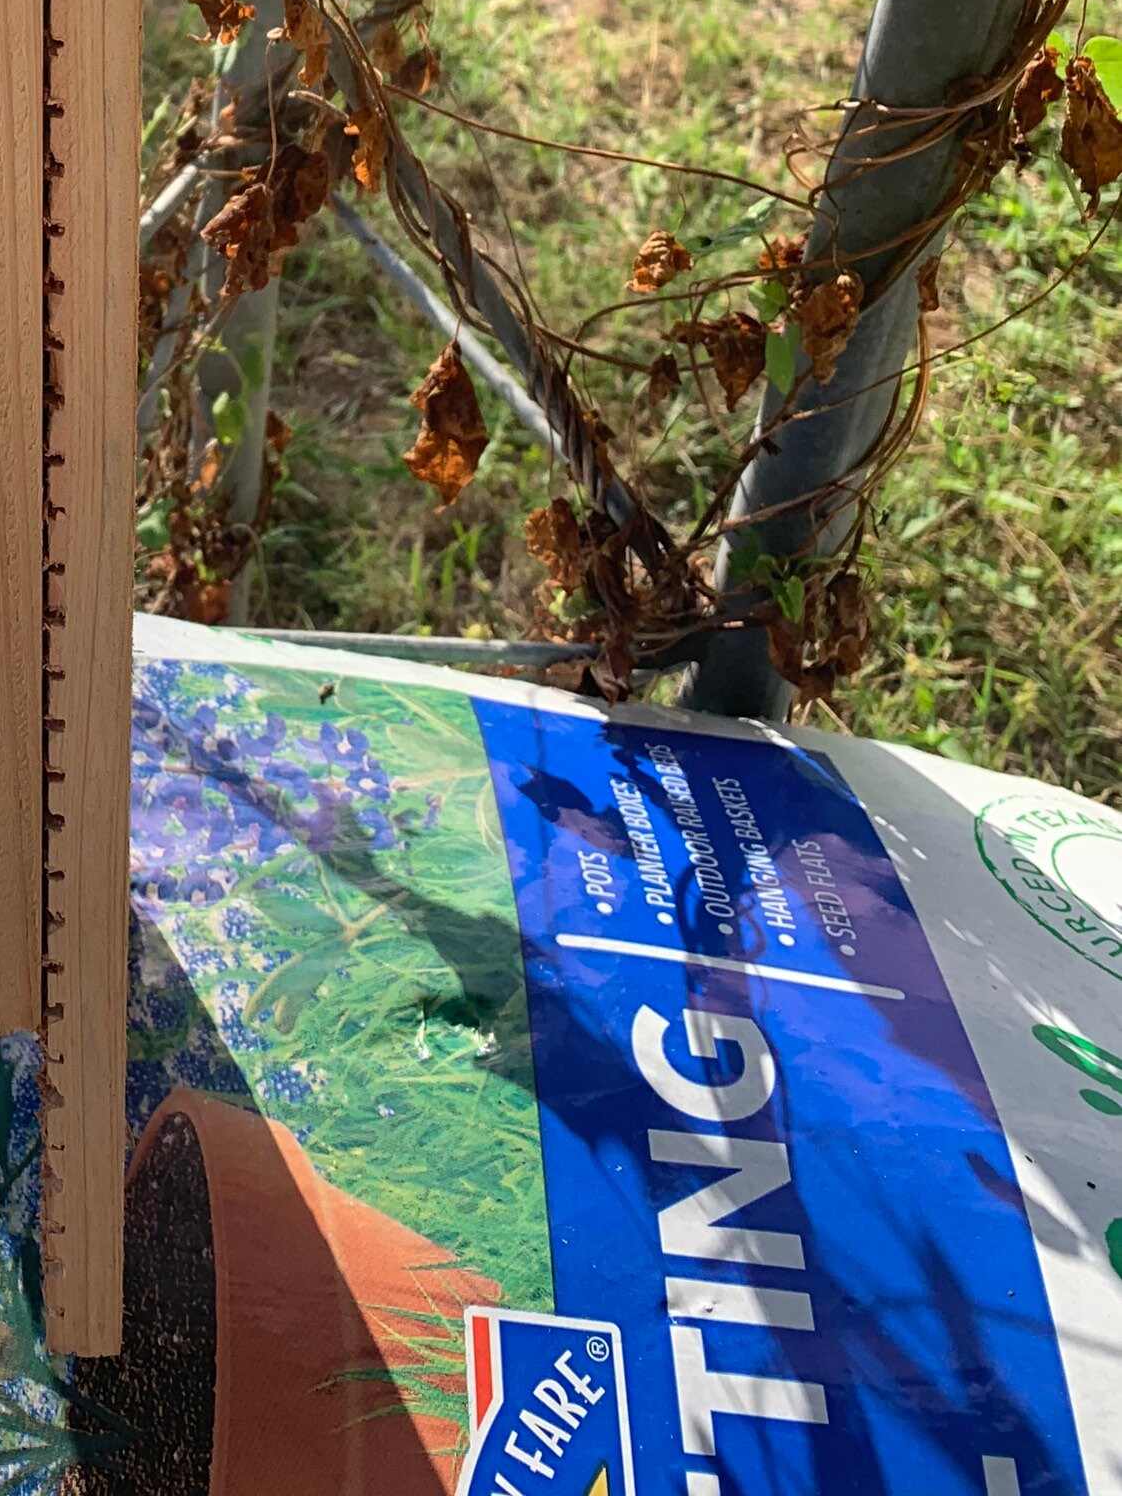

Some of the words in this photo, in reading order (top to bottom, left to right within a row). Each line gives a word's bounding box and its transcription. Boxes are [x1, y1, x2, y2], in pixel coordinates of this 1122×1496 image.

[645, 743, 684, 776] BEDS
[609, 778, 649, 827] BOXES
[662, 774, 704, 827] RAISED
[711, 777, 763, 842] BASKETS
[792, 840, 832, 887] FLATS
[1005, 826, 1038, 854] IN
[577, 850, 616, 899] POTS
[628, 826, 676, 908] PLANTER
[681, 825, 736, 919] OUTDOOR
[738, 842, 796, 930] HANGING
[815, 890, 857, 941] SEED
[631, 1004, 829, 1496] TING
[504, 1349, 606, 1479] FARE
